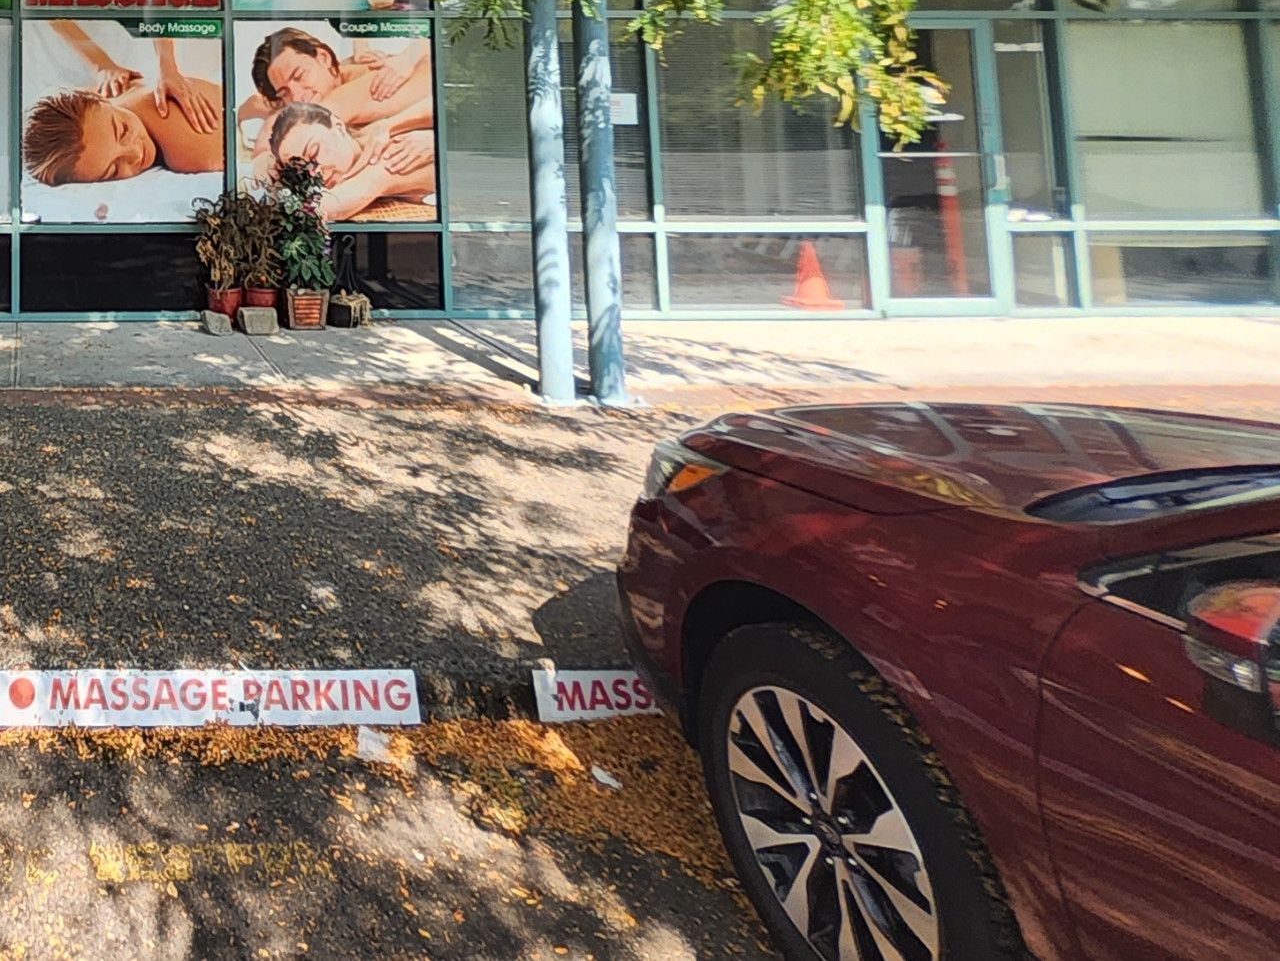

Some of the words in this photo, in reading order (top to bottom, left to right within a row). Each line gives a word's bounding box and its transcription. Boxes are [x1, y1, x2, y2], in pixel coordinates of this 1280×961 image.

[138, 23, 166, 34] Body
[168, 23, 216, 34] Massage
[339, 22, 378, 34] Couple
[380, 22, 430, 34] Massage
[48, 678, 228, 711] MASSAGE
[243, 678, 411, 711] PARKING
[556, 679, 660, 710] MASS
